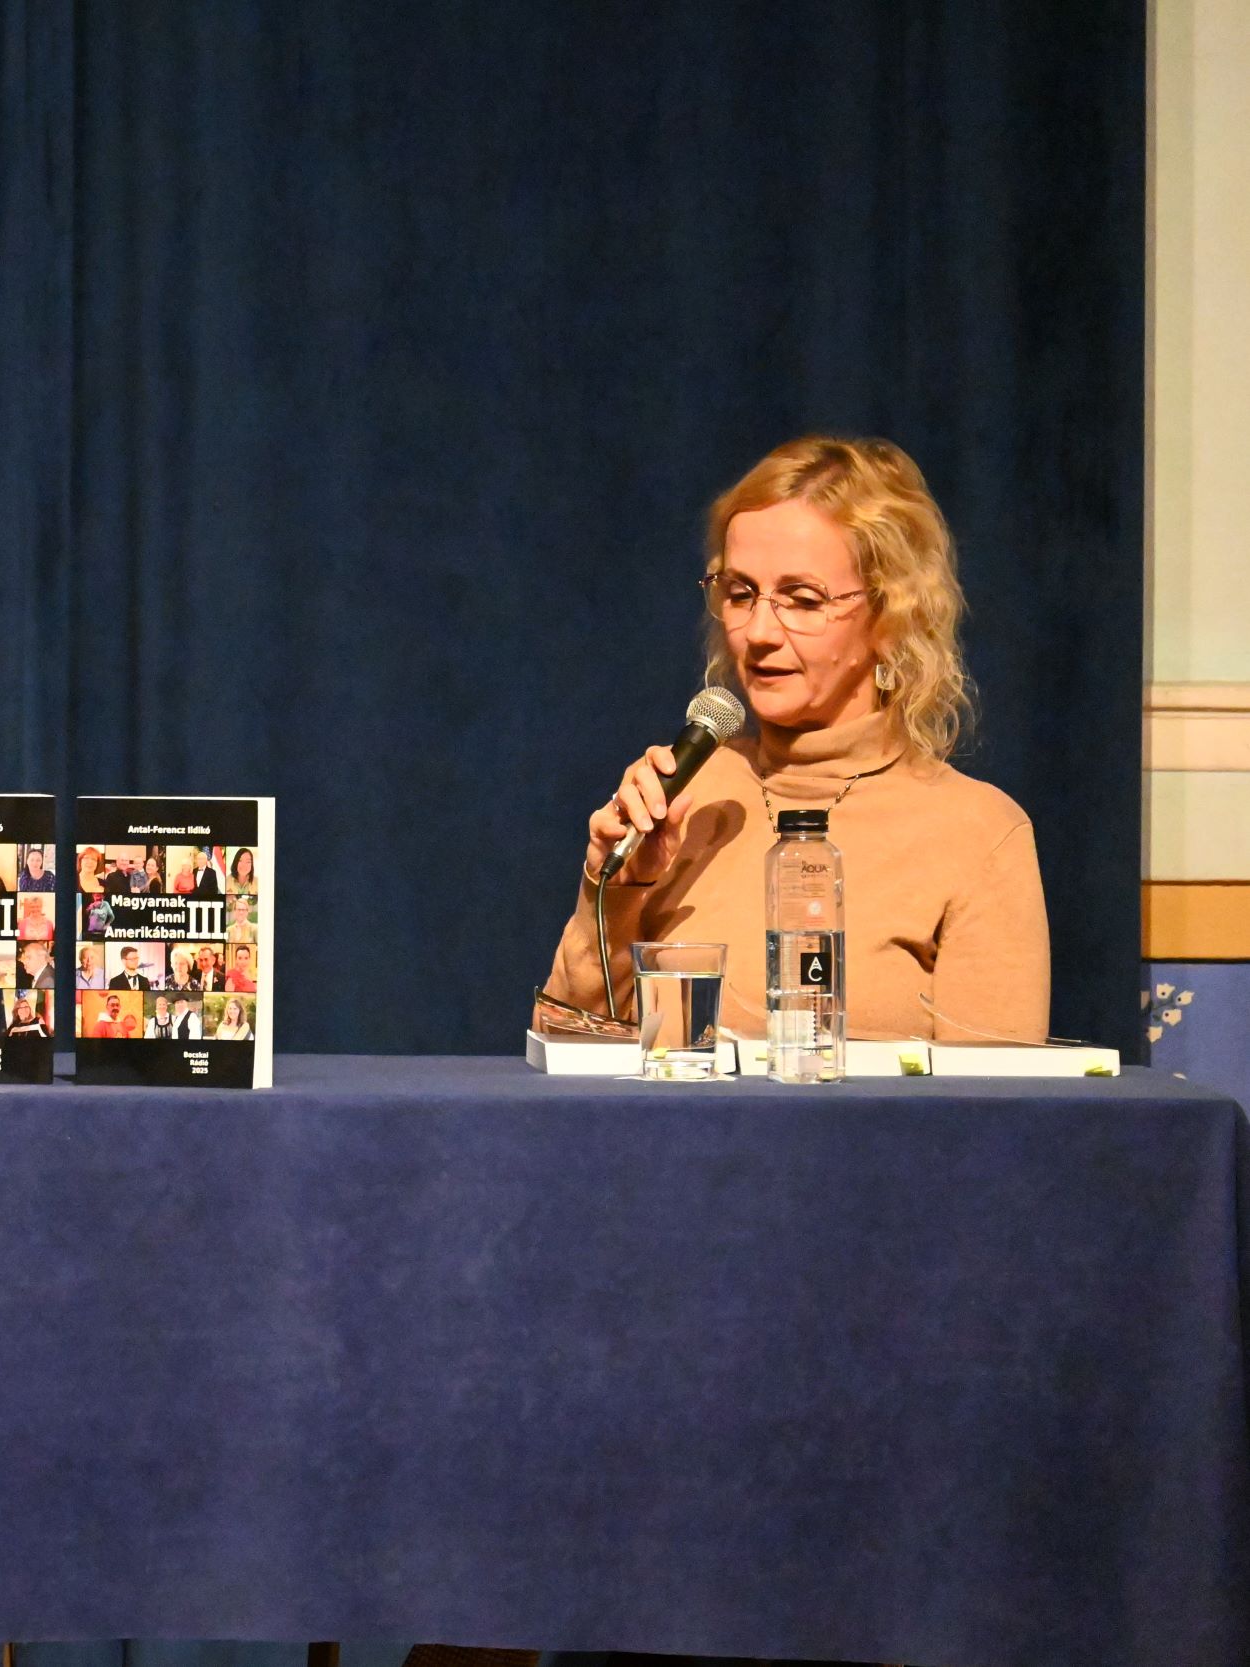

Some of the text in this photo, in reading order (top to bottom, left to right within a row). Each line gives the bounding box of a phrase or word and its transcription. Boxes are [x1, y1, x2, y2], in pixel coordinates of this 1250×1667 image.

[127, 824, 211, 835] Antal-Ferencz Ildikó
[111, 894, 186, 910] Magyarnak
[152, 910, 186, 924] lenni
[104, 926, 186, 940] Amerikában
